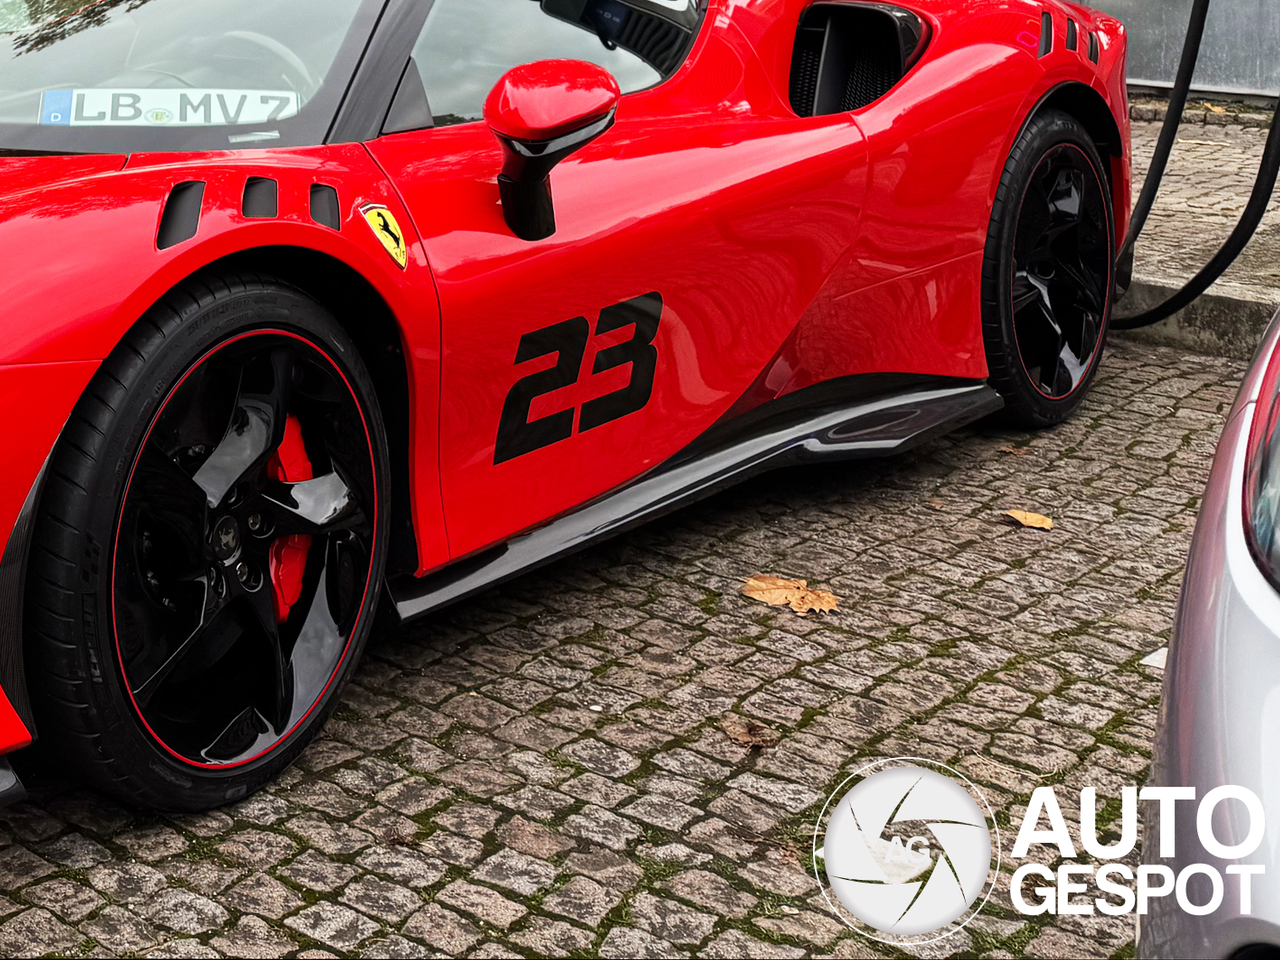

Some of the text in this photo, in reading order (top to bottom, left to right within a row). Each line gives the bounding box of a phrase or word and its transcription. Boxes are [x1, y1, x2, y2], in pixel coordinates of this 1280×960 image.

[51, 112, 61, 122] D
[73, 93, 291, 124] LB MV 7
[493, 291, 664, 466] 23
